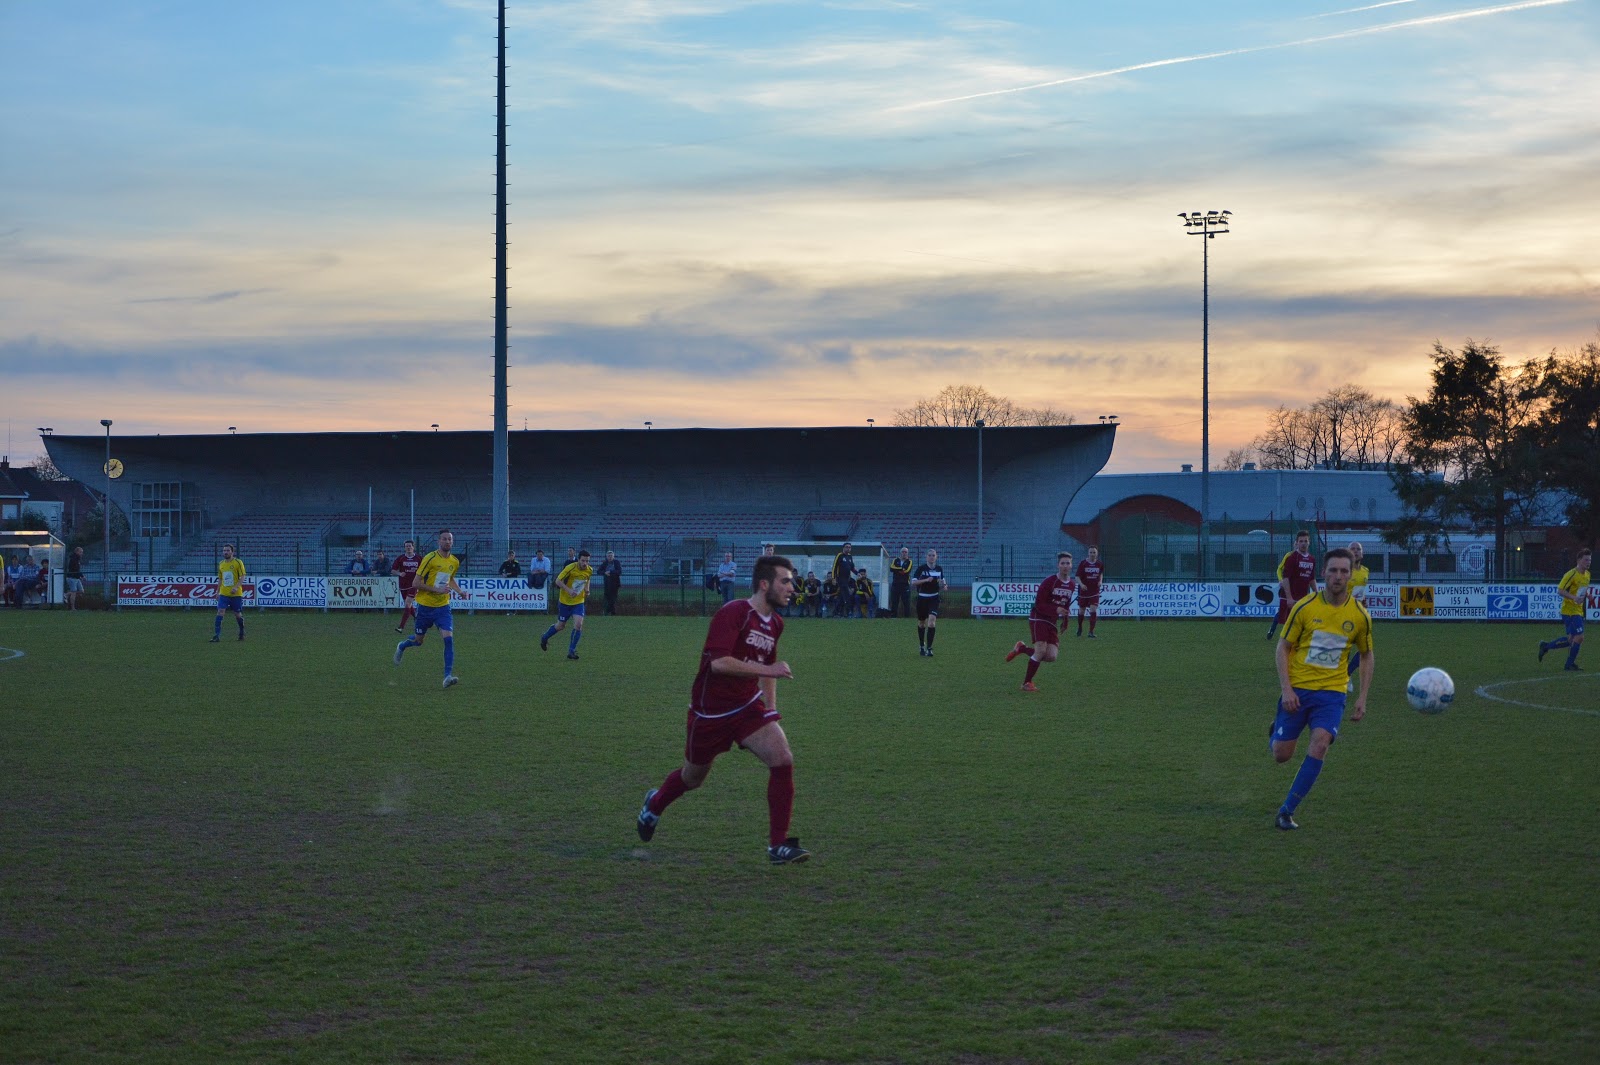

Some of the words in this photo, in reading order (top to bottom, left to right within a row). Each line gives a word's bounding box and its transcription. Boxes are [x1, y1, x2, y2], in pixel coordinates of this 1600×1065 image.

[277, 577, 325, 588] OPTIEK
[327, 578, 379, 586] KOFFIEBRANDERIJ
[458, 579, 533, 590] RIESMAN
[333, 586, 373, 599] ROM
[999, 583, 1039, 593] KESSELD
[1138, 584, 1168, 593] GARAGE
[1169, 583, 1207, 593] ROMIS
[1368, 584, 1396, 596] Slagerij
[1487, 586, 1536, 594] KESSEL-LO
[1540, 586, 1558, 594] MOT
[276, 588, 327, 599] MERTENS
[488, 591, 544, 601] Keukens
[999, 593, 1037, 602] WILSELSESTW
[1400, 586, 1433, 603] JM
[259, 598, 325, 606] WWW.OPTIEKMERTENS.BE
[327, 599, 378, 607] www.romkoffie.be
[1463, 597, 1470, 605] A
[973, 606, 1000, 614] SPAR
[1224, 606, 1280, 616] J.S.SOLUT
[1370, 610, 1396, 618] ENBERG
[1434, 608, 1487, 617] BOORTMEERBEEK
